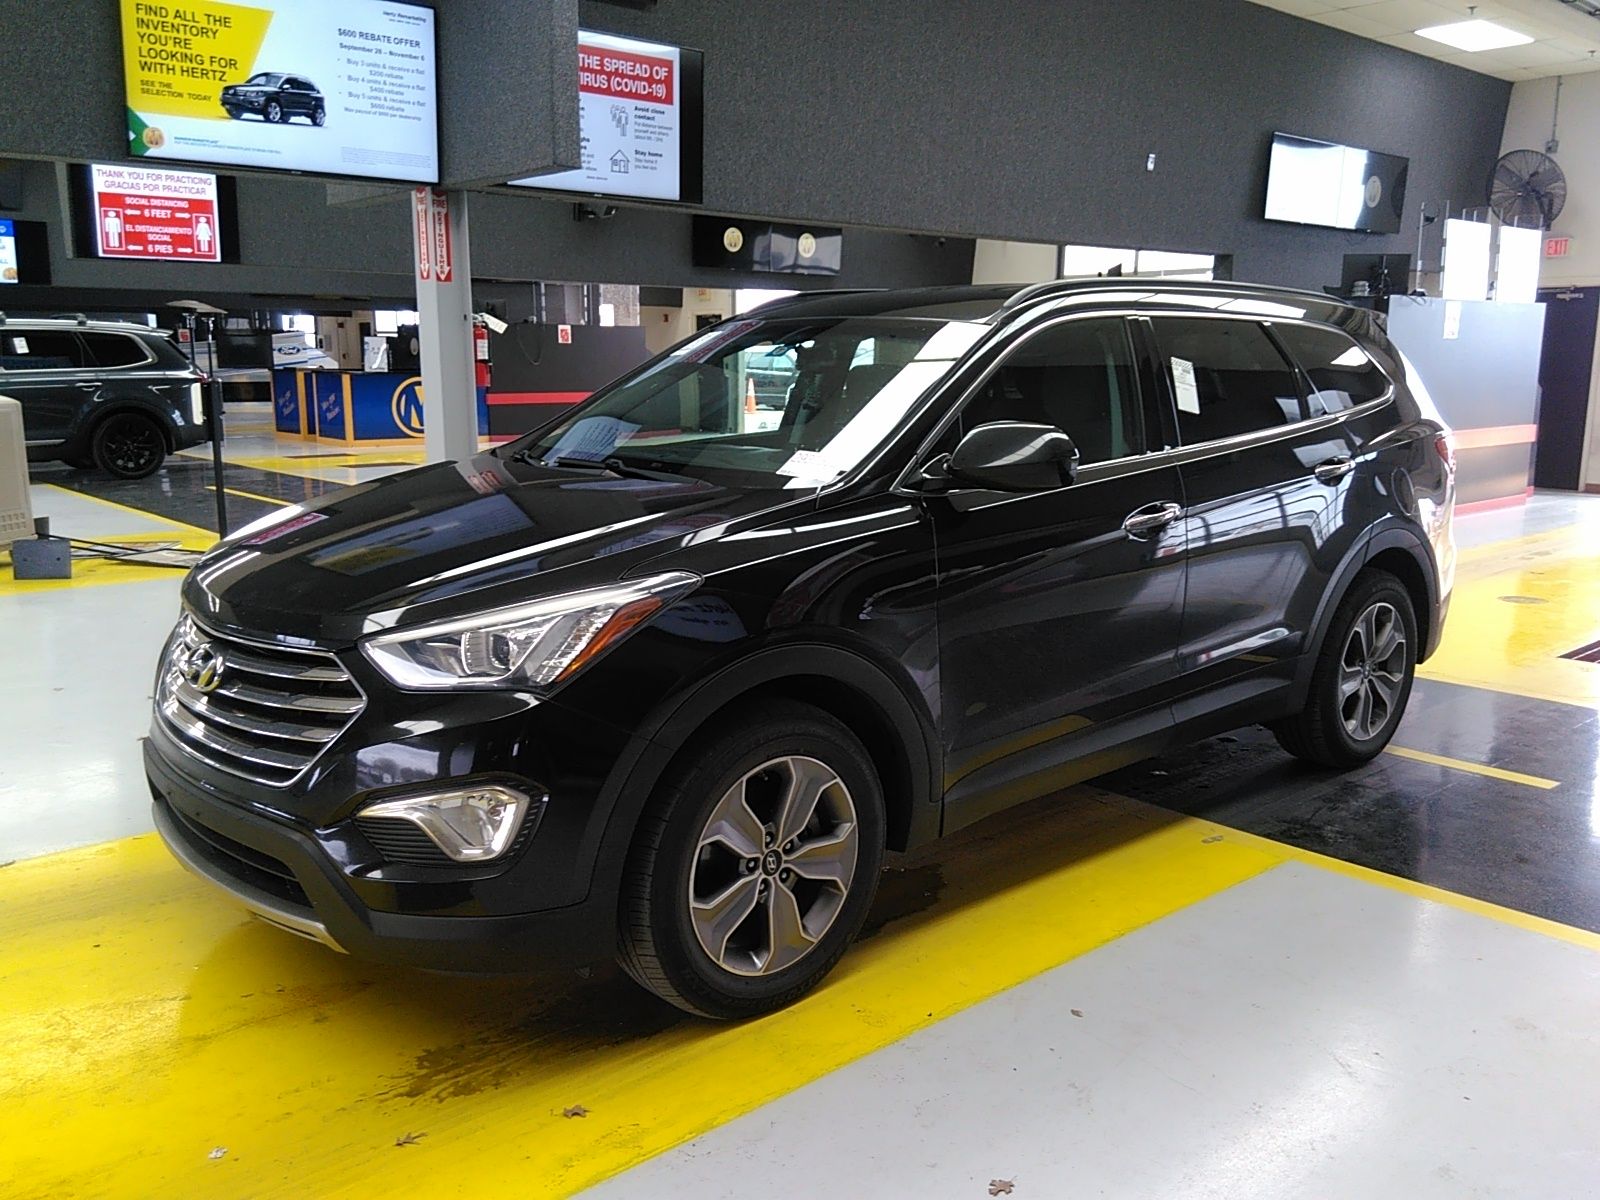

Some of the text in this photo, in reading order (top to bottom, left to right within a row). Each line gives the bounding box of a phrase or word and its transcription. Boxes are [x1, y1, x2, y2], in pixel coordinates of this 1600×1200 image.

[136, 3, 232, 28] FIND ALL THE
[136, 18, 219, 39] INVENTORY
[137, 32, 192, 50] YOU'RE
[338, 28, 421, 48] $600 REBATE OFFER
[139, 47, 238, 70] LOOKING FOR
[339, 42, 373, 53] September
[389, 50, 419, 60] November
[347, 58, 359, 66] Buy
[578, 53, 668, 80] THE SPREAD OF
[139, 61, 227, 82] WITH HERTZ
[347, 75, 359, 83] Buy
[140, 79, 173, 89] SEE THE
[578, 72, 667, 99] IRUS (COVID-19)
[141, 88, 212, 101] SELECTION TODAY
[634, 149, 647, 157] Stay
[96, 169, 212, 186] THANK YOU FOR PRACTICING
[104, 180, 206, 195] GRACIAS POR PRACTICAR
[125, 197, 189, 208] SOCIAL DISTANCING
[433, 200, 447, 208] FIRE
[144, 209, 172, 218] 6 FEET
[135, 225, 192, 235] DISTANCIAMIENTO
[148, 234, 172, 242] SOCIAL
[437, 211, 446, 275] EXTINGUISHER
[147, 245, 173, 254] 6 PIES
[1547, 240, 1568, 256] EXIT
